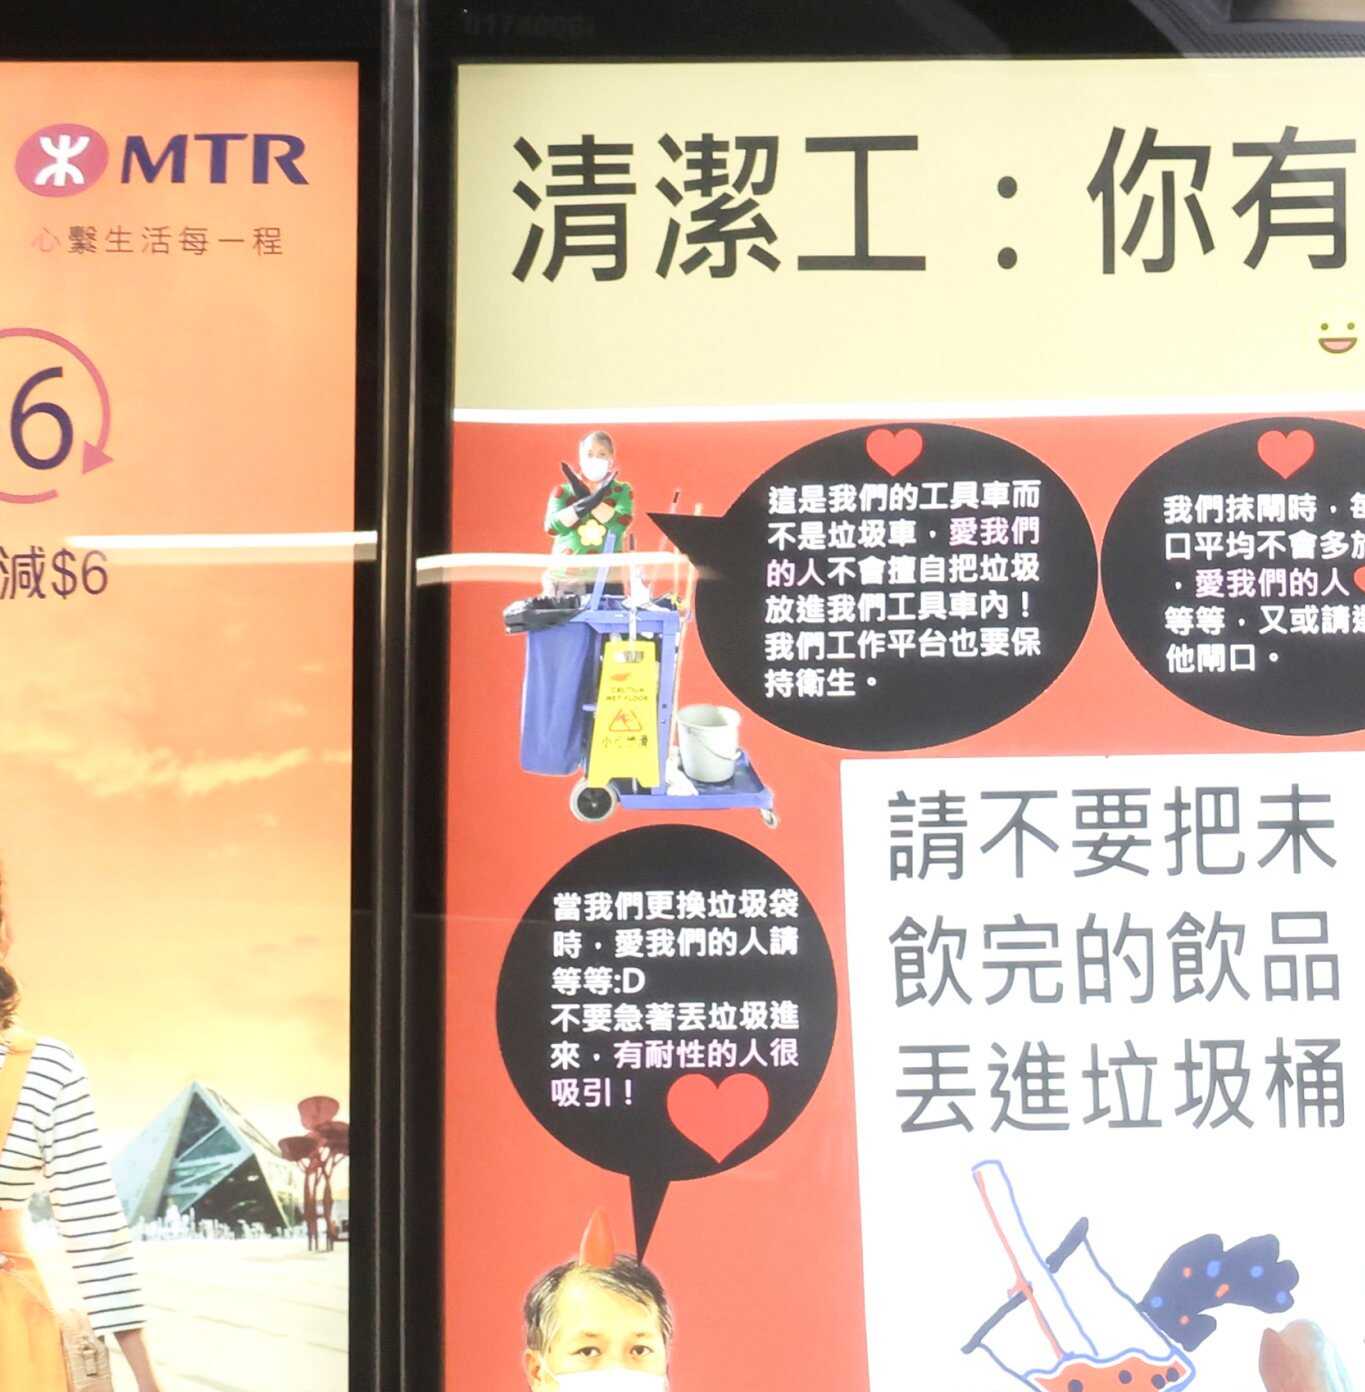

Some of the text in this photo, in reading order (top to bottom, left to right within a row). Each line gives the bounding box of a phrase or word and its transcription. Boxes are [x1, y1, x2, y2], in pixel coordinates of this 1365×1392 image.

[120, 133, 310, 186] MTR
[768, 480, 1042, 515] 這是我們的工具車而
[766, 552, 1041, 588] 的人不會擅自把垃圾
[765, 626, 1042, 662] 我們工作平台也要保
[1166, 643, 1280, 674] 他閘口。
[765, 667, 878, 699] 持衛生。
[888, 783, 1338, 881] 請不要把未
[552, 889, 799, 922] 當我們更換垃圾袋
[888, 910, 1342, 1009] 飲完的飲品
[550, 1000, 799, 1033] 不要急著丟垃圾進
[895, 1036, 1346, 1134] 丟進垃圾桶
